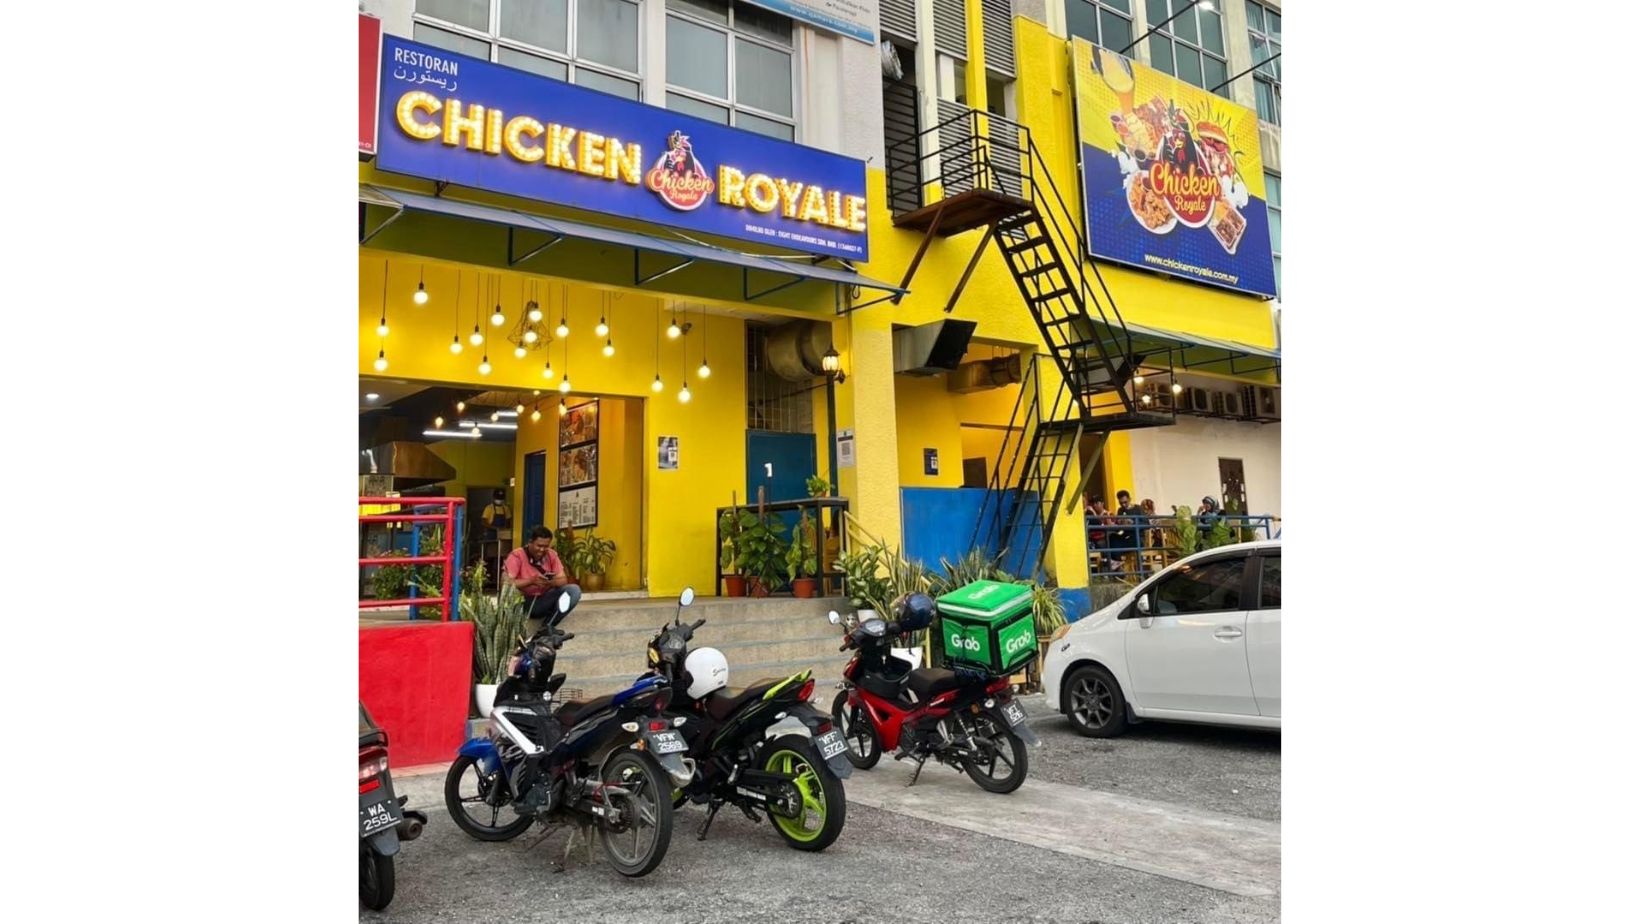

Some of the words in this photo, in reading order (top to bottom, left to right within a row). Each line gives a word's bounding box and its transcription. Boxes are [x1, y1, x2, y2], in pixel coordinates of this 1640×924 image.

[394, 47, 458, 76] RESTORAN
[396, 90, 642, 185] CHICKEN
[718, 164, 867, 232] ROYALE
[646, 168, 715, 195] Chicken
[1150, 161, 1221, 197] Chicken
[1174, 194, 1207, 216] Royale
[951, 633, 981, 652] Grab
[1006, 629, 1032, 654] Grab
[823, 740, 845, 756] 5723
[363, 811, 398, 831] 259L
[367, 803, 386, 817] WA
